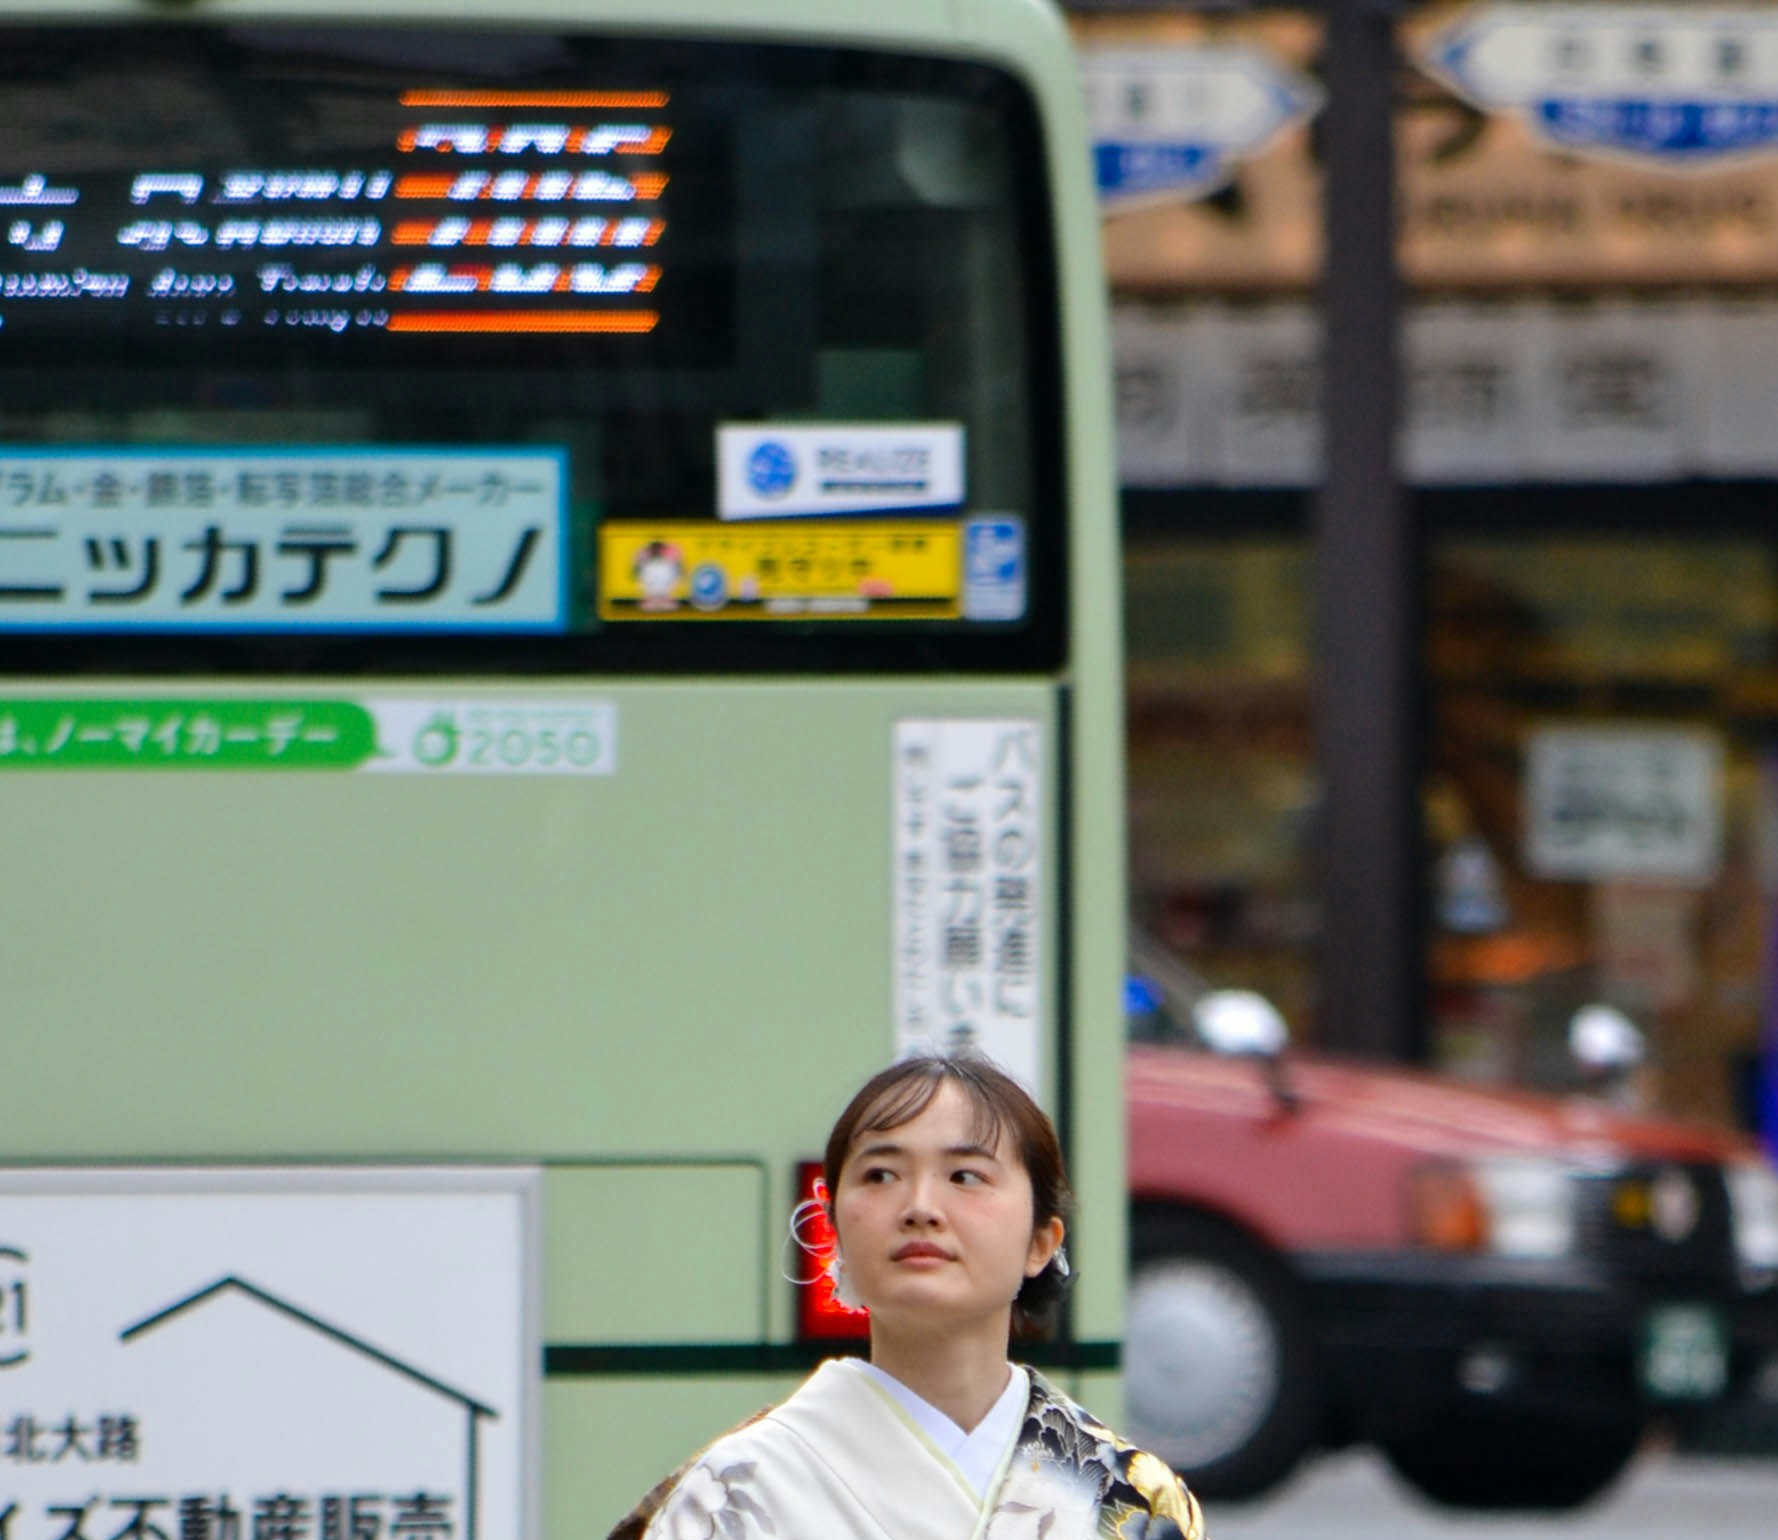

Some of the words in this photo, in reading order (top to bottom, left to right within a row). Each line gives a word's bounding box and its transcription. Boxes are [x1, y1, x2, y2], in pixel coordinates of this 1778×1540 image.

[0, 525, 543, 607] ニッカテクノ
[7, 1415, 141, 1464] 北大路
